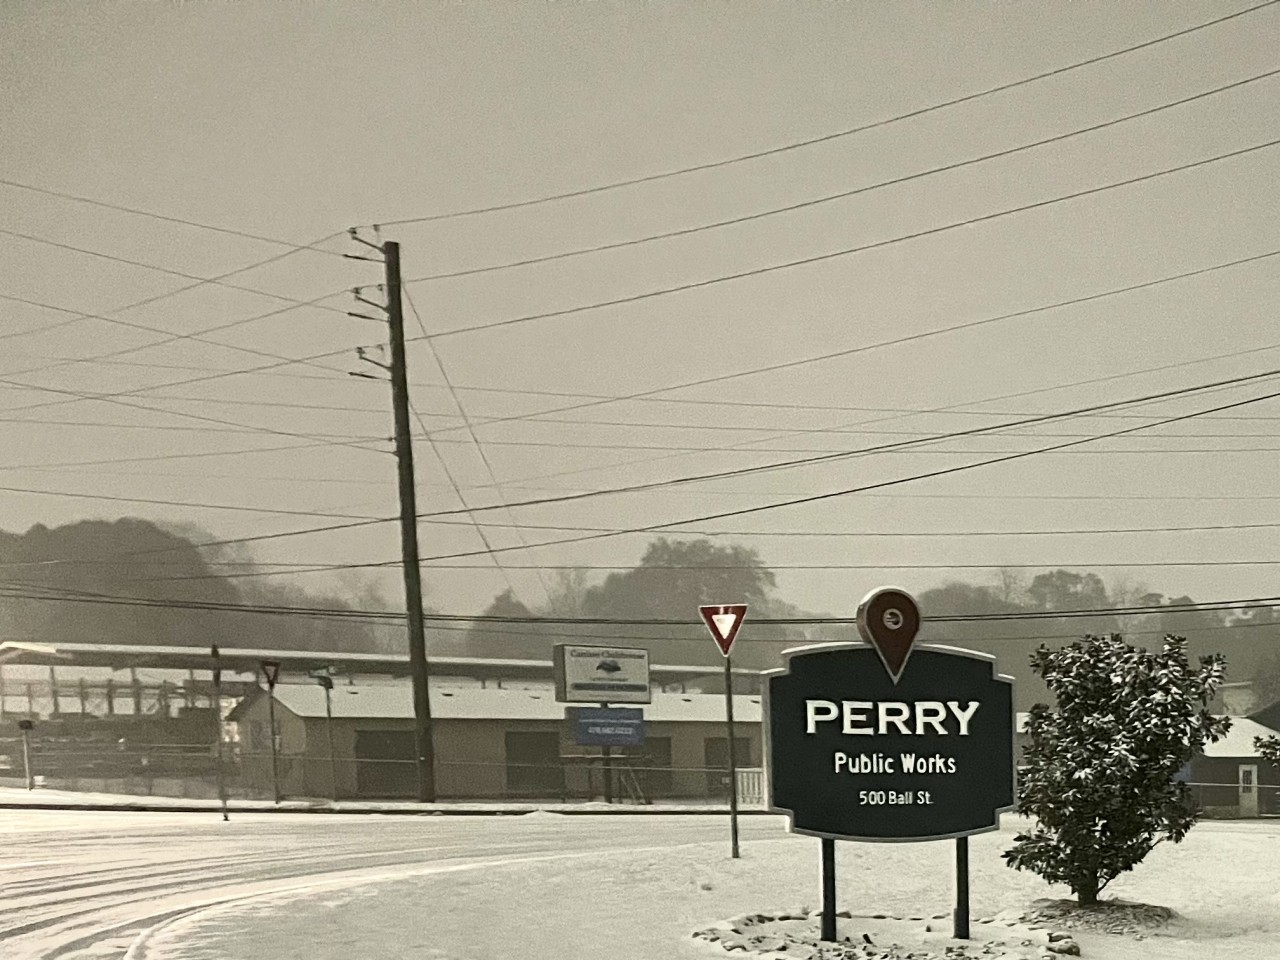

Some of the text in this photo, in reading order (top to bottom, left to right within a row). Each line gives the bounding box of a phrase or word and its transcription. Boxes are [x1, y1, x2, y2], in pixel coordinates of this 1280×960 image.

[805, 699, 980, 736] PERRY
[834, 751, 957, 774] Public Works
[859, 790, 886, 805] 500
[888, 790, 913, 805] Ball
